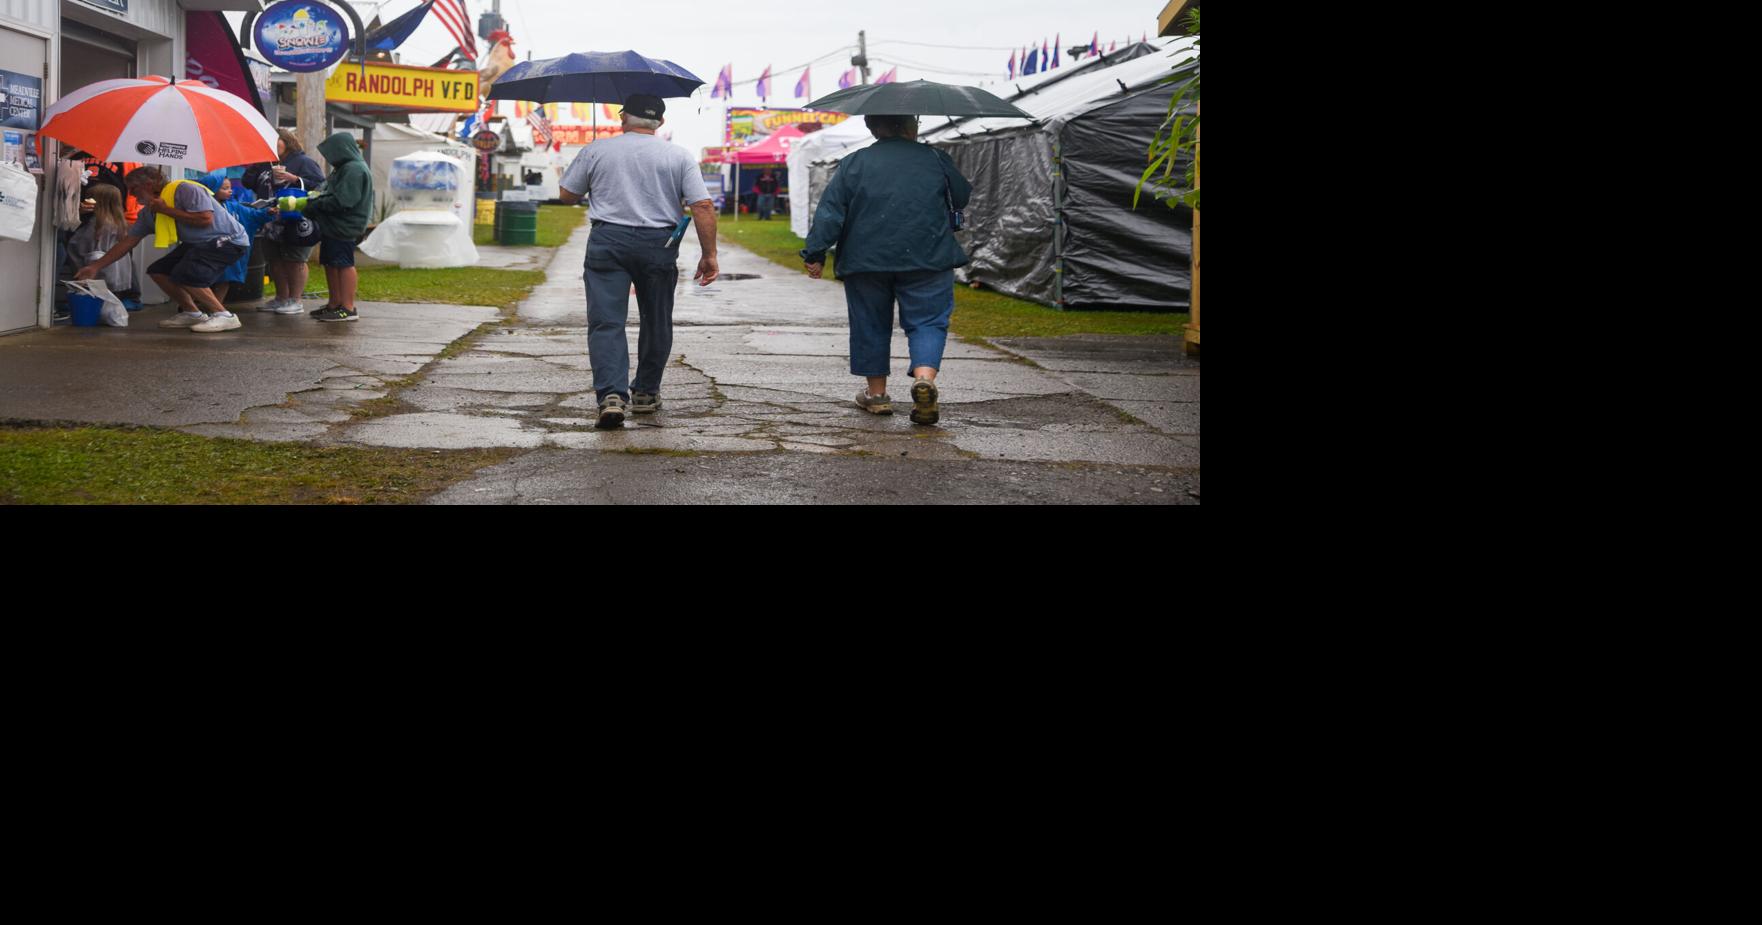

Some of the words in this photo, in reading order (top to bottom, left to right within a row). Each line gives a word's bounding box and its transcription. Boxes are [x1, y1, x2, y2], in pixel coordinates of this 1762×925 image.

[346, 72, 434, 98] RANDOLPH
[764, 112, 817, 128] FUNNEL
[158, 152, 184, 160] HANDS
